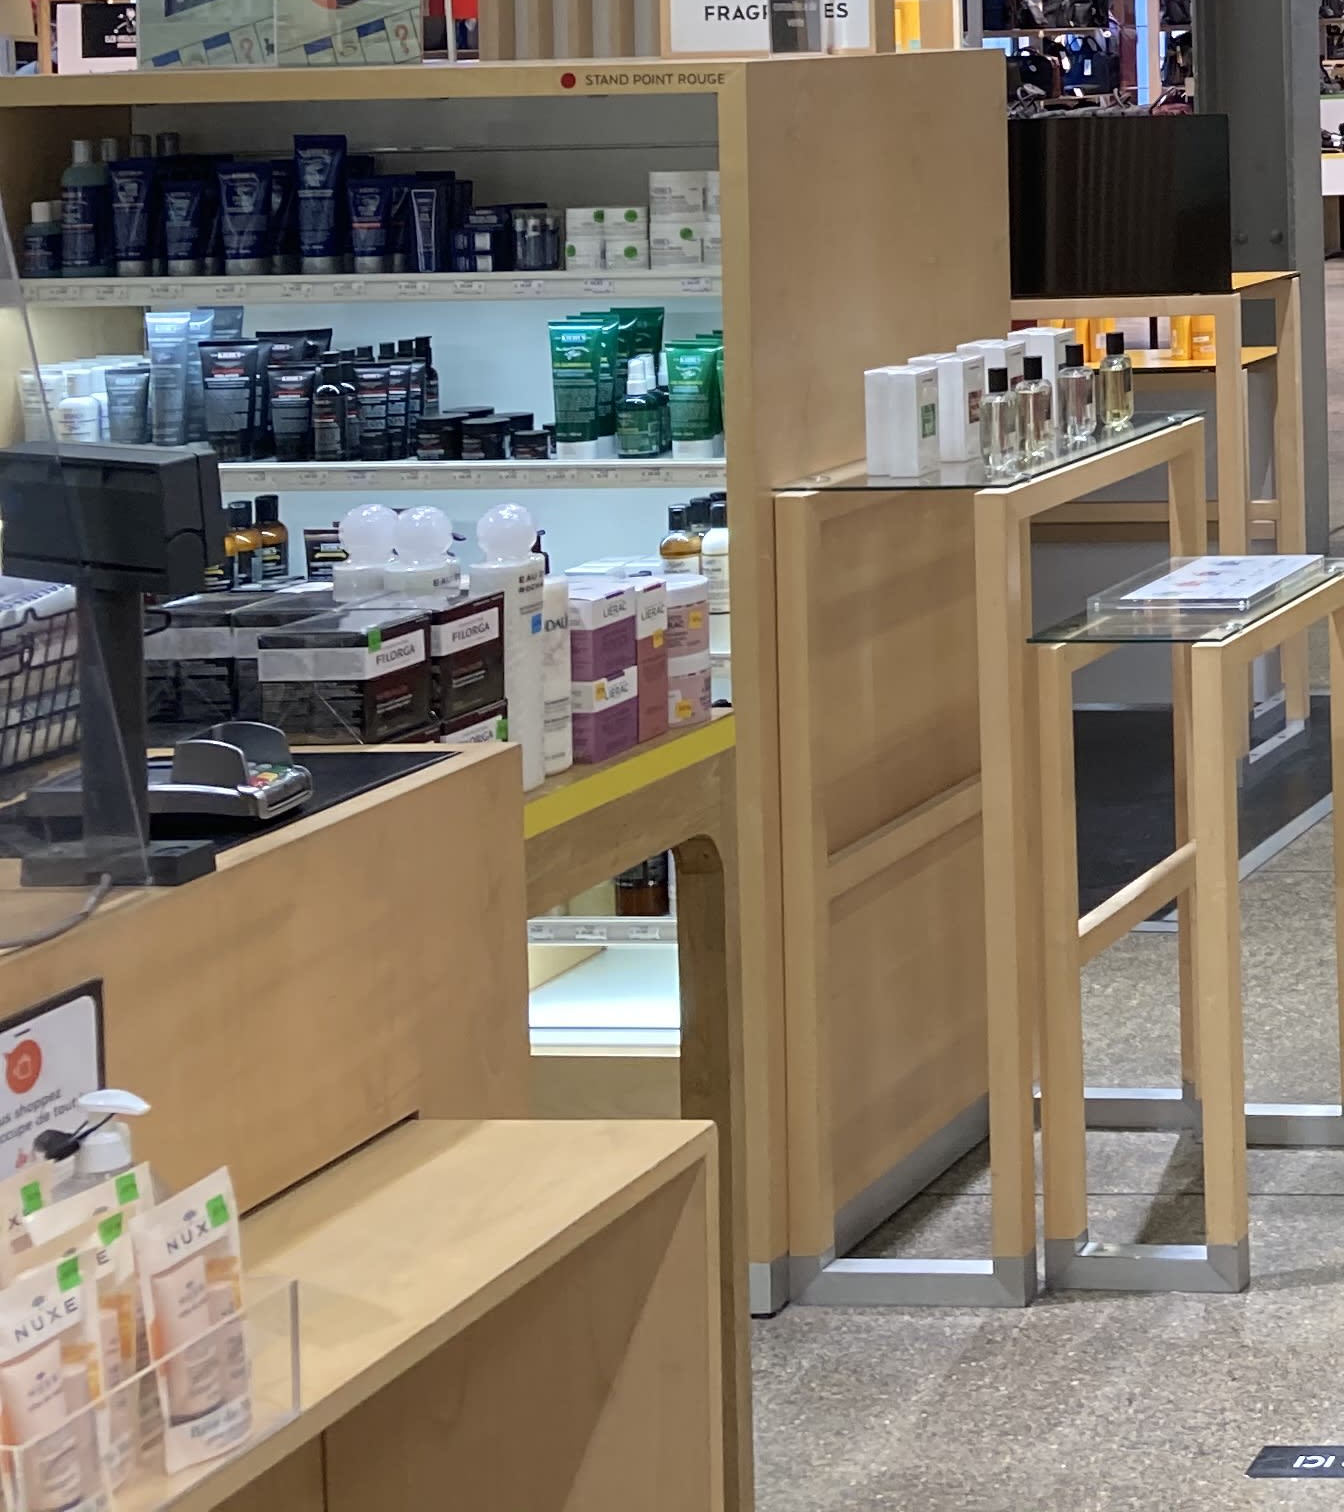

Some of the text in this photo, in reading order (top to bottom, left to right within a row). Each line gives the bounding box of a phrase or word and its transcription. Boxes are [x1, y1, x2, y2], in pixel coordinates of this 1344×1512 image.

[585, 72, 726, 86] STAND POINT ROUGE
[452, 621, 492, 643] FILORGA
[375, 643, 417, 666] FILORGA
[166, 1221, 211, 1255] NUX
[13, 1295, 79, 1343] NUXE
[1292, 1454, 1332, 1470] ICI
